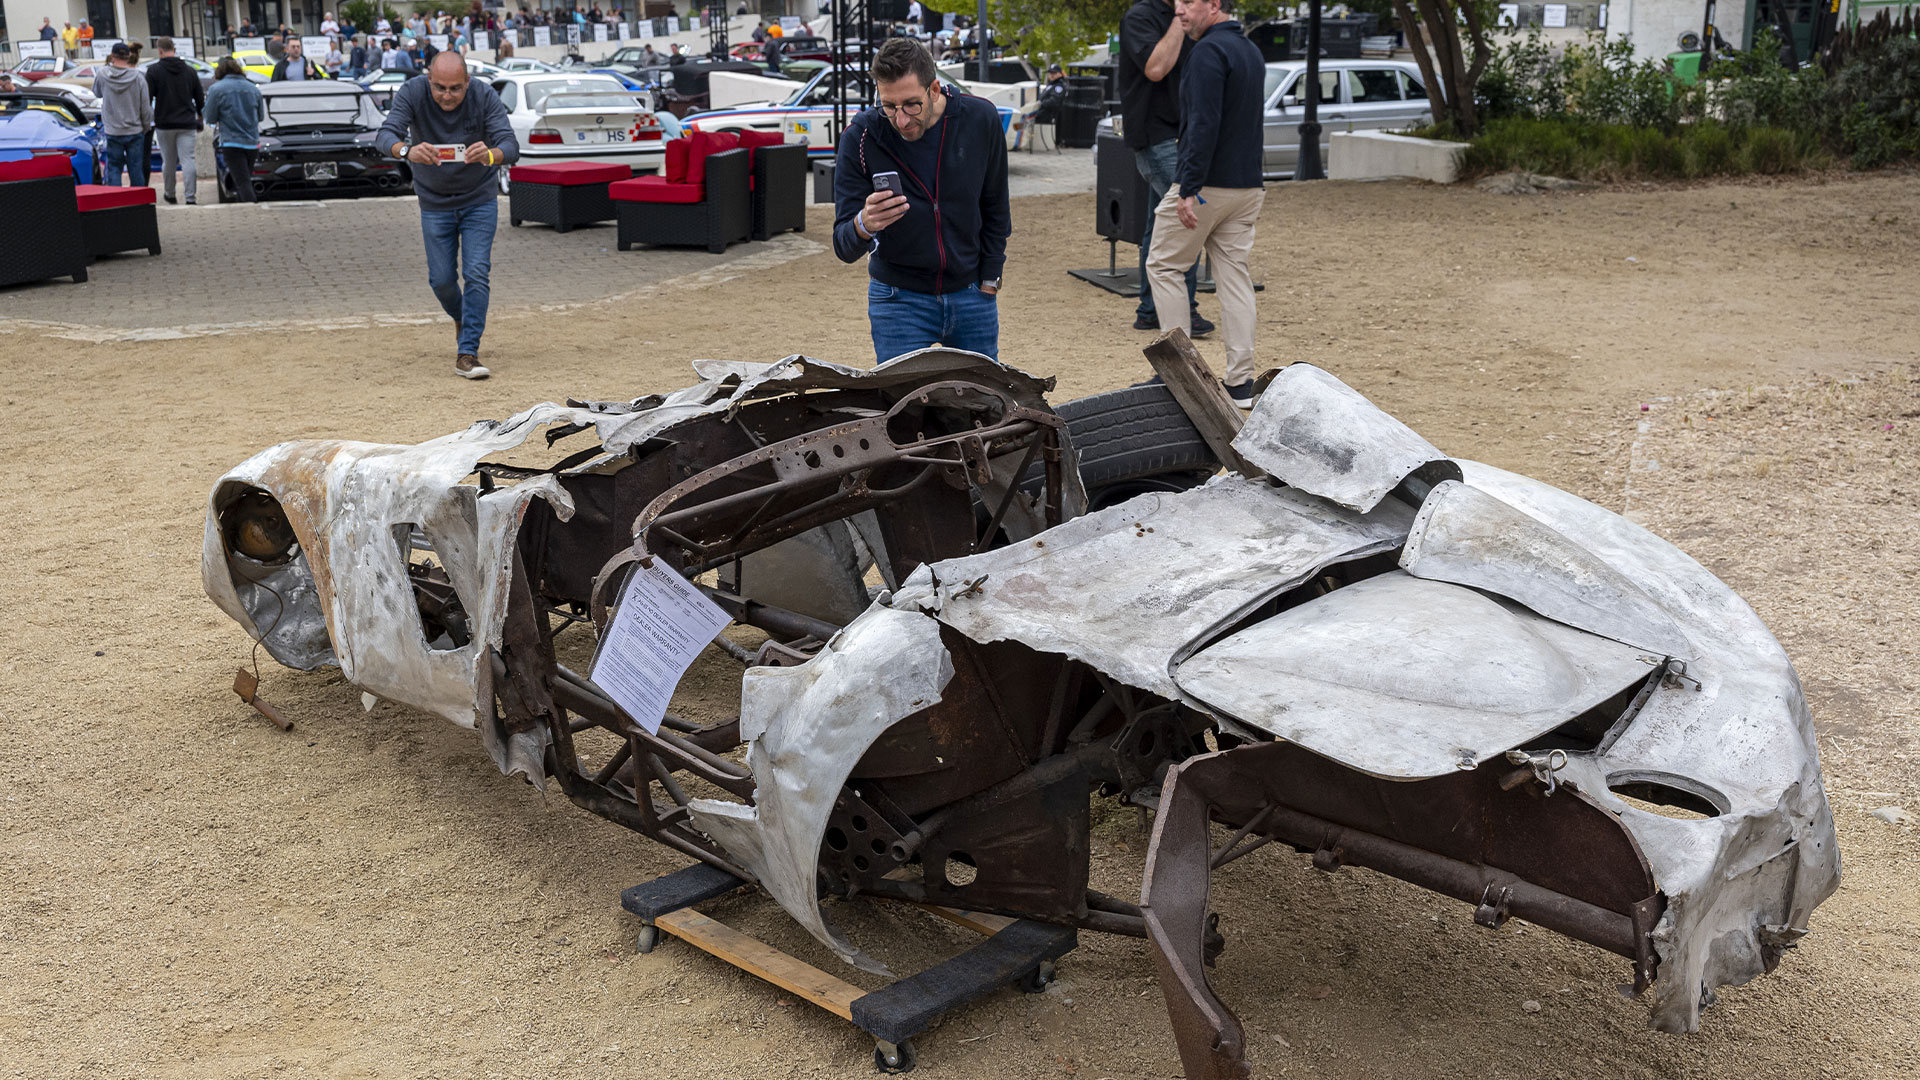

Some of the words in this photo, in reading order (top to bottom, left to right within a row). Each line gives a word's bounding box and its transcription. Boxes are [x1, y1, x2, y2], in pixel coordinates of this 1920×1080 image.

[607, 130, 625, 142] HS
[797, 122, 808, 131] TS
[823, 119, 832, 144] 1
[652, 565, 674, 585] BUYERS
[673, 583, 691, 598] GUIDE
[633, 613, 652, 633] DEALER
[651, 630, 680, 656] WARRANTY
[653, 612, 669, 627] DEALER
[668, 624, 690, 644] WARRANTY
